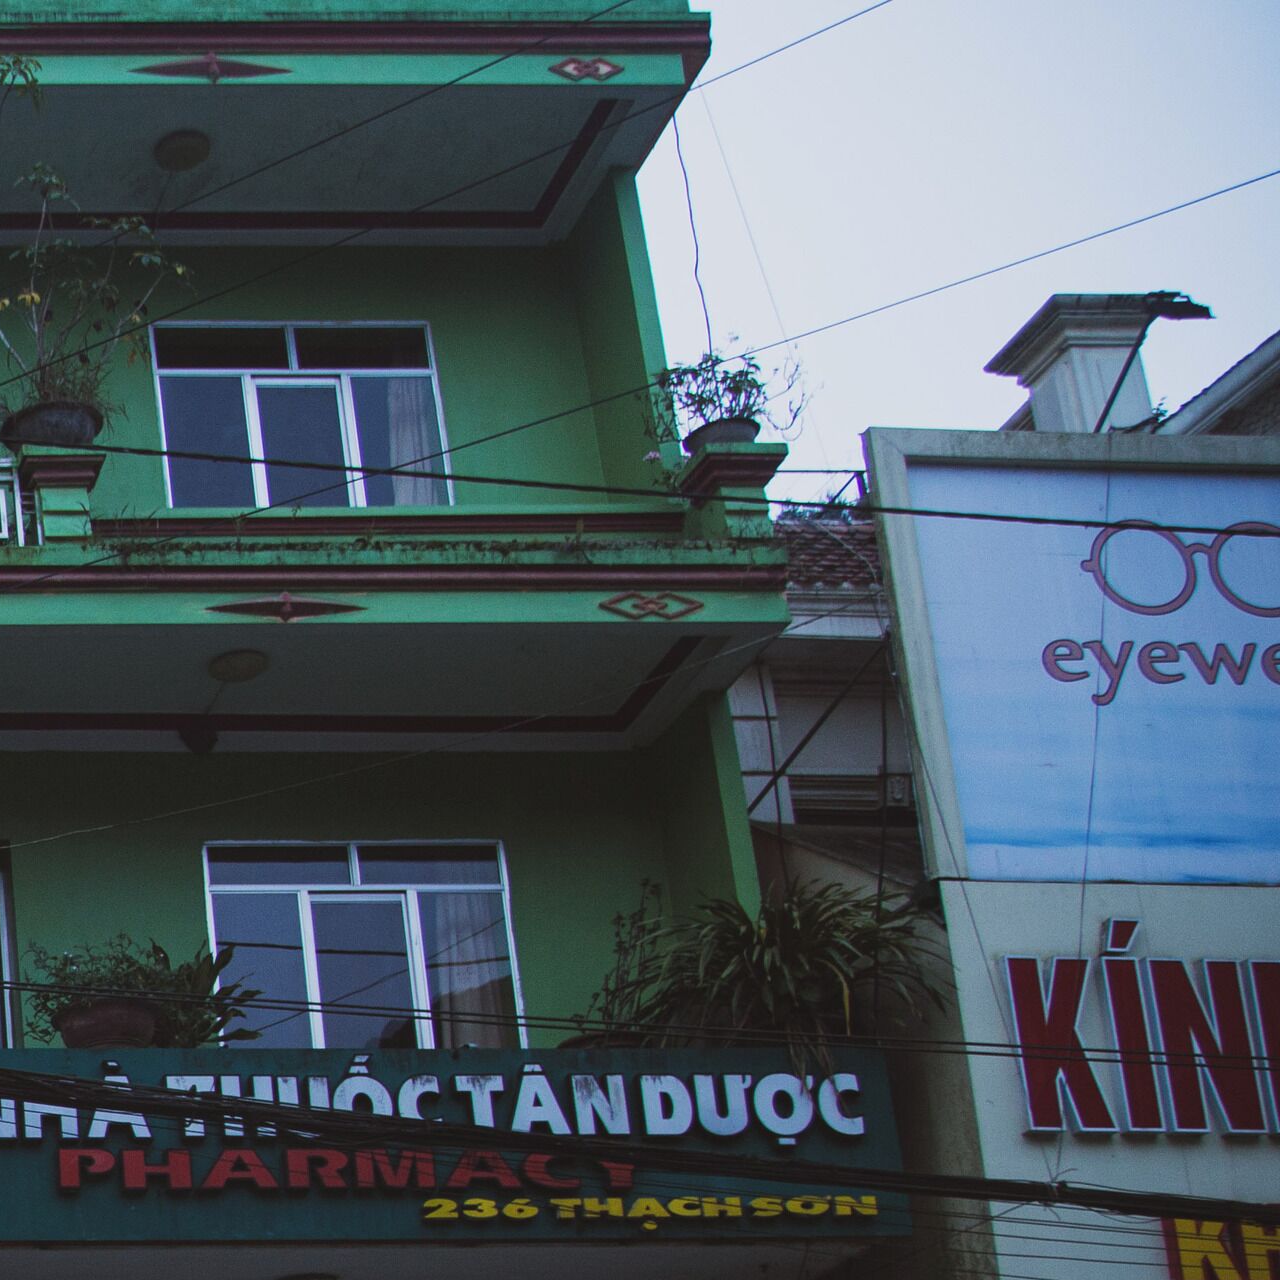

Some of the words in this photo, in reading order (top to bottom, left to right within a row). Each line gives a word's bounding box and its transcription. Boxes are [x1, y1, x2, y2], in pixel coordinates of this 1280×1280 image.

[455, 1063, 630, 1136] TÂN
[641, 1072, 865, 1145] DƯỢC
[57, 1147, 635, 1189] PHARMACY
[422, 1197, 538, 1220] 236
[555, 1195, 744, 1231] THẠCH
[748, 1194, 879, 1217] SƠN
